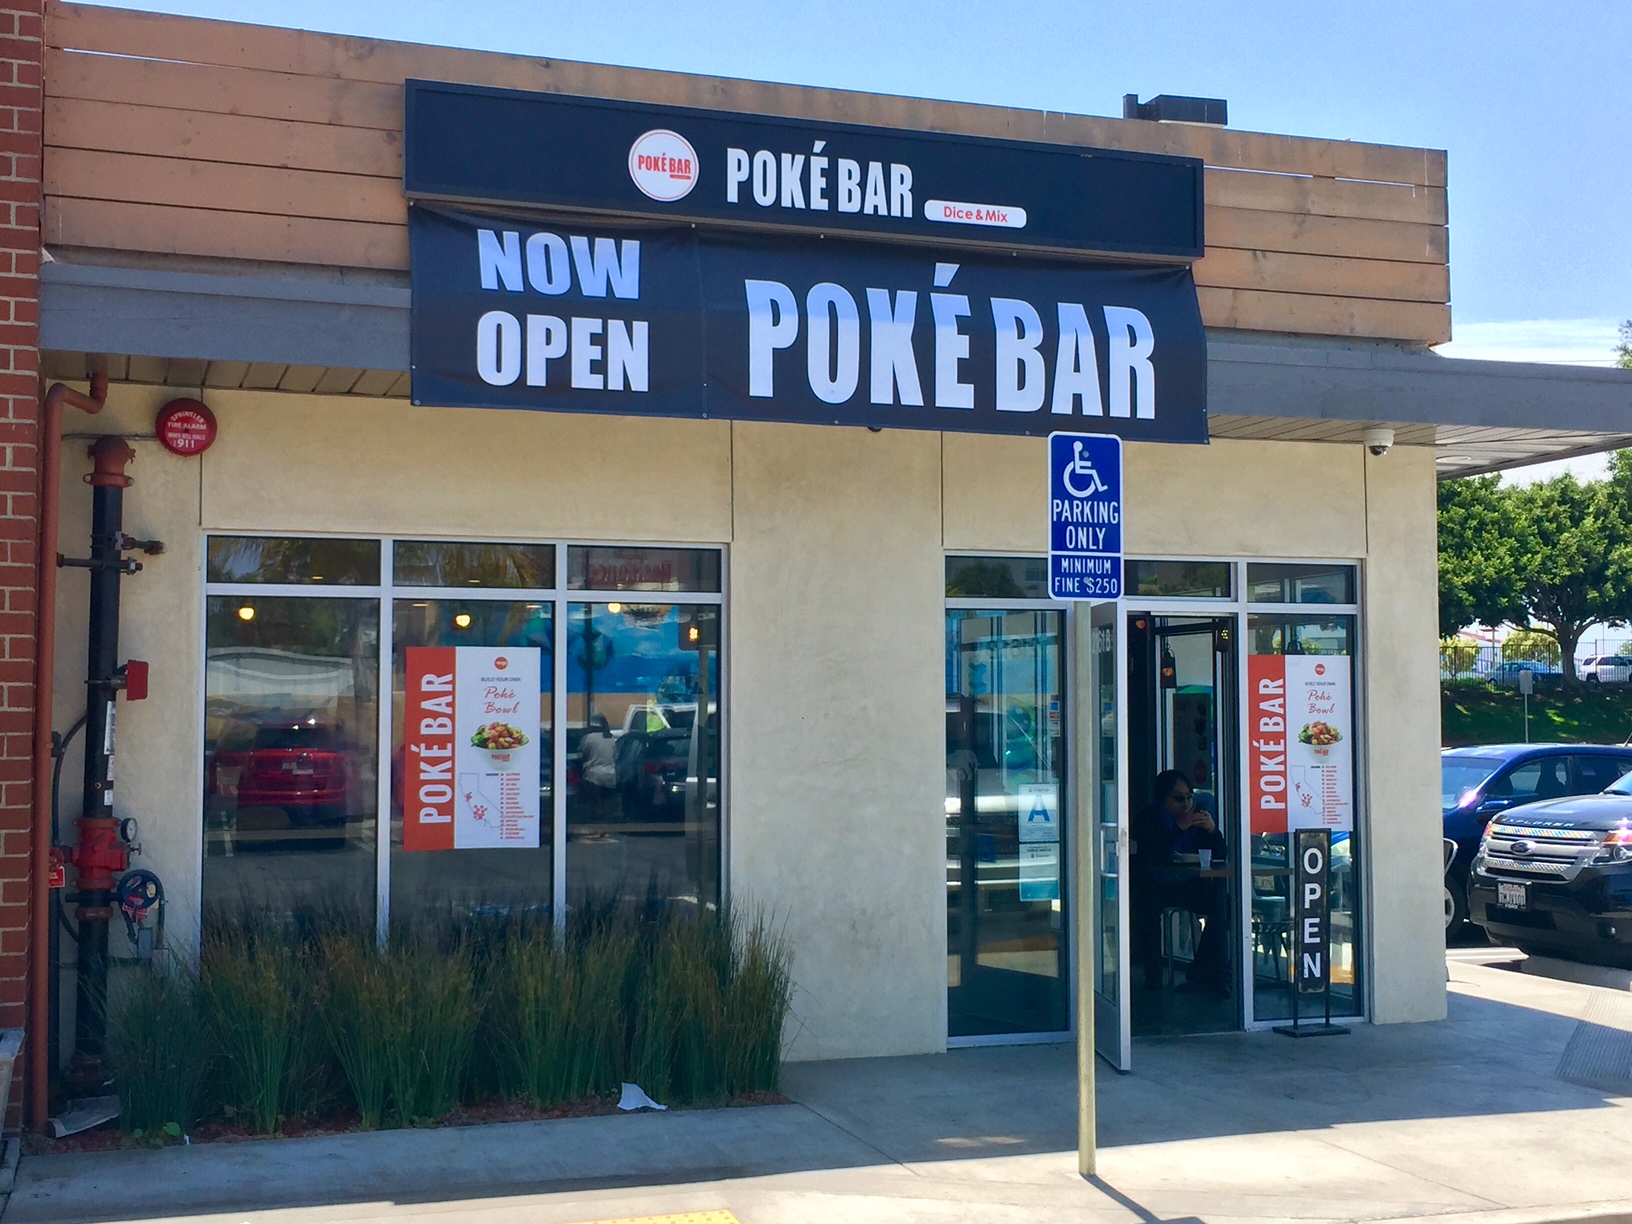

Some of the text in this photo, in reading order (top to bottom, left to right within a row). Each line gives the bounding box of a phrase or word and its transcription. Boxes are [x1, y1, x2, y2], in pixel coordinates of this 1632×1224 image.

[637, 152, 691, 174] POKÉ BAR
[727, 140, 913, 218] POKÉ BAR
[477, 229, 640, 299] NOW
[476, 310, 649, 392] OPEN
[744, 262, 1156, 420] POKÉ BAR
[177, 439, 195, 448] 911
[1053, 499, 1119, 524] PARKING
[1066, 525, 1106, 550] ONLY
[1061, 557, 1111, 575] MINIMUM
[1054, 576, 1118, 595] FINE $250
[483, 701, 520, 714] Bowl
[1307, 702, 1336, 714] Bowl
[410, 673, 454, 824] POKÉ BAR
[1252, 678, 1286, 810] POKÉ BAR
[1027, 794, 1051, 822] A
[1303, 847, 1323, 979] OPEN
